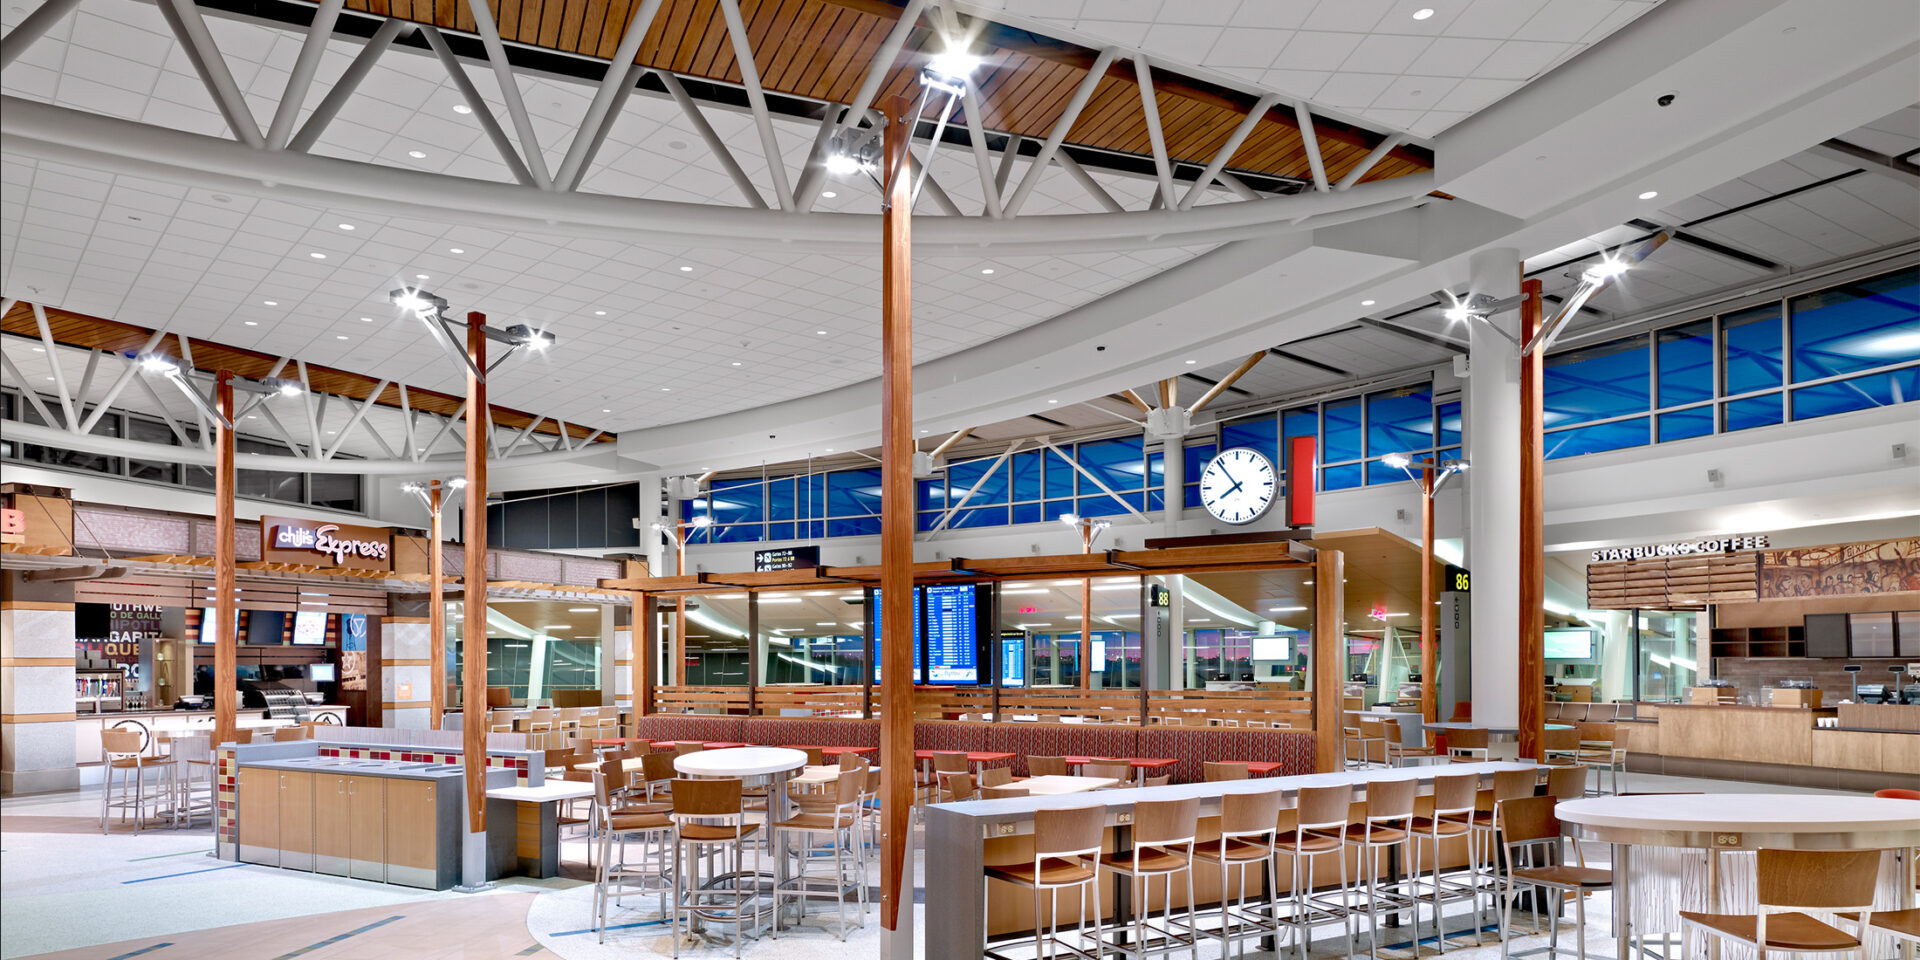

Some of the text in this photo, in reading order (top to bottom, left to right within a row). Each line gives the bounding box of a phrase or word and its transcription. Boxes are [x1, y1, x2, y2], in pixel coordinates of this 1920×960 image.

[1, 509, 26, 533] B
[278, 524, 388, 564] chili's Express
[1591, 535, 1766, 562] STARBUCKS COFFEE
[1456, 573, 1469, 590] 86
[1159, 592, 1169, 606] 88
[120, 611, 133, 619] DE
